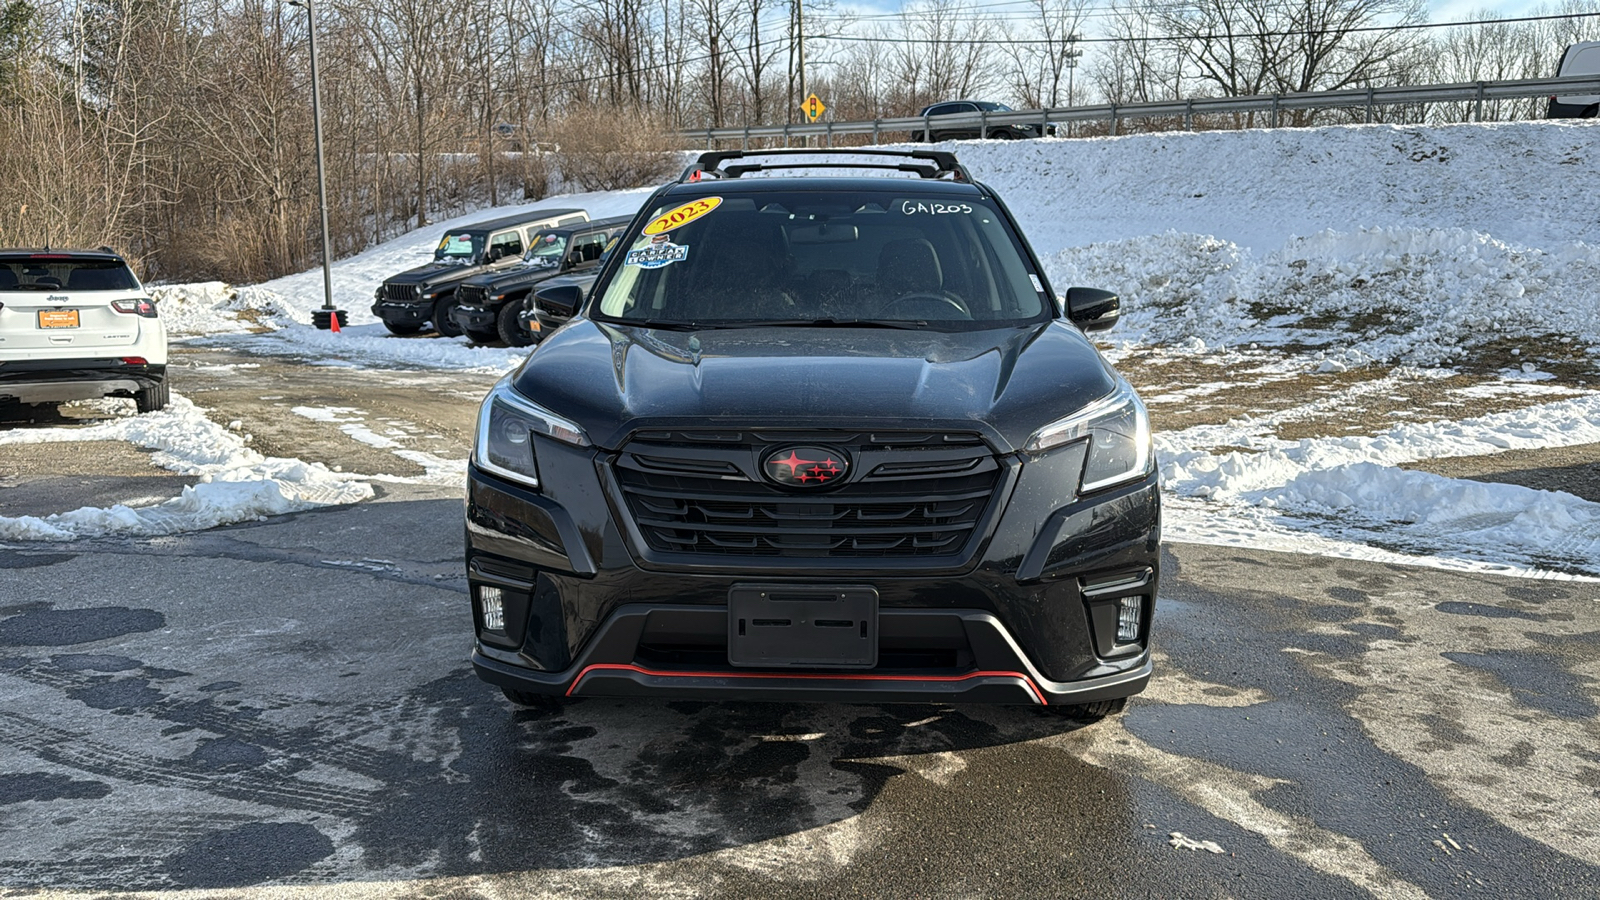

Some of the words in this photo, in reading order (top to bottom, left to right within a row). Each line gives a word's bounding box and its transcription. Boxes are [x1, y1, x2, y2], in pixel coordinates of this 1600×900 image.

[902, 200, 973, 215] GA1203
[656, 201, 710, 230] 2023
[630, 248, 684, 258] CARFAX
[638, 253, 682, 262] OWNER
